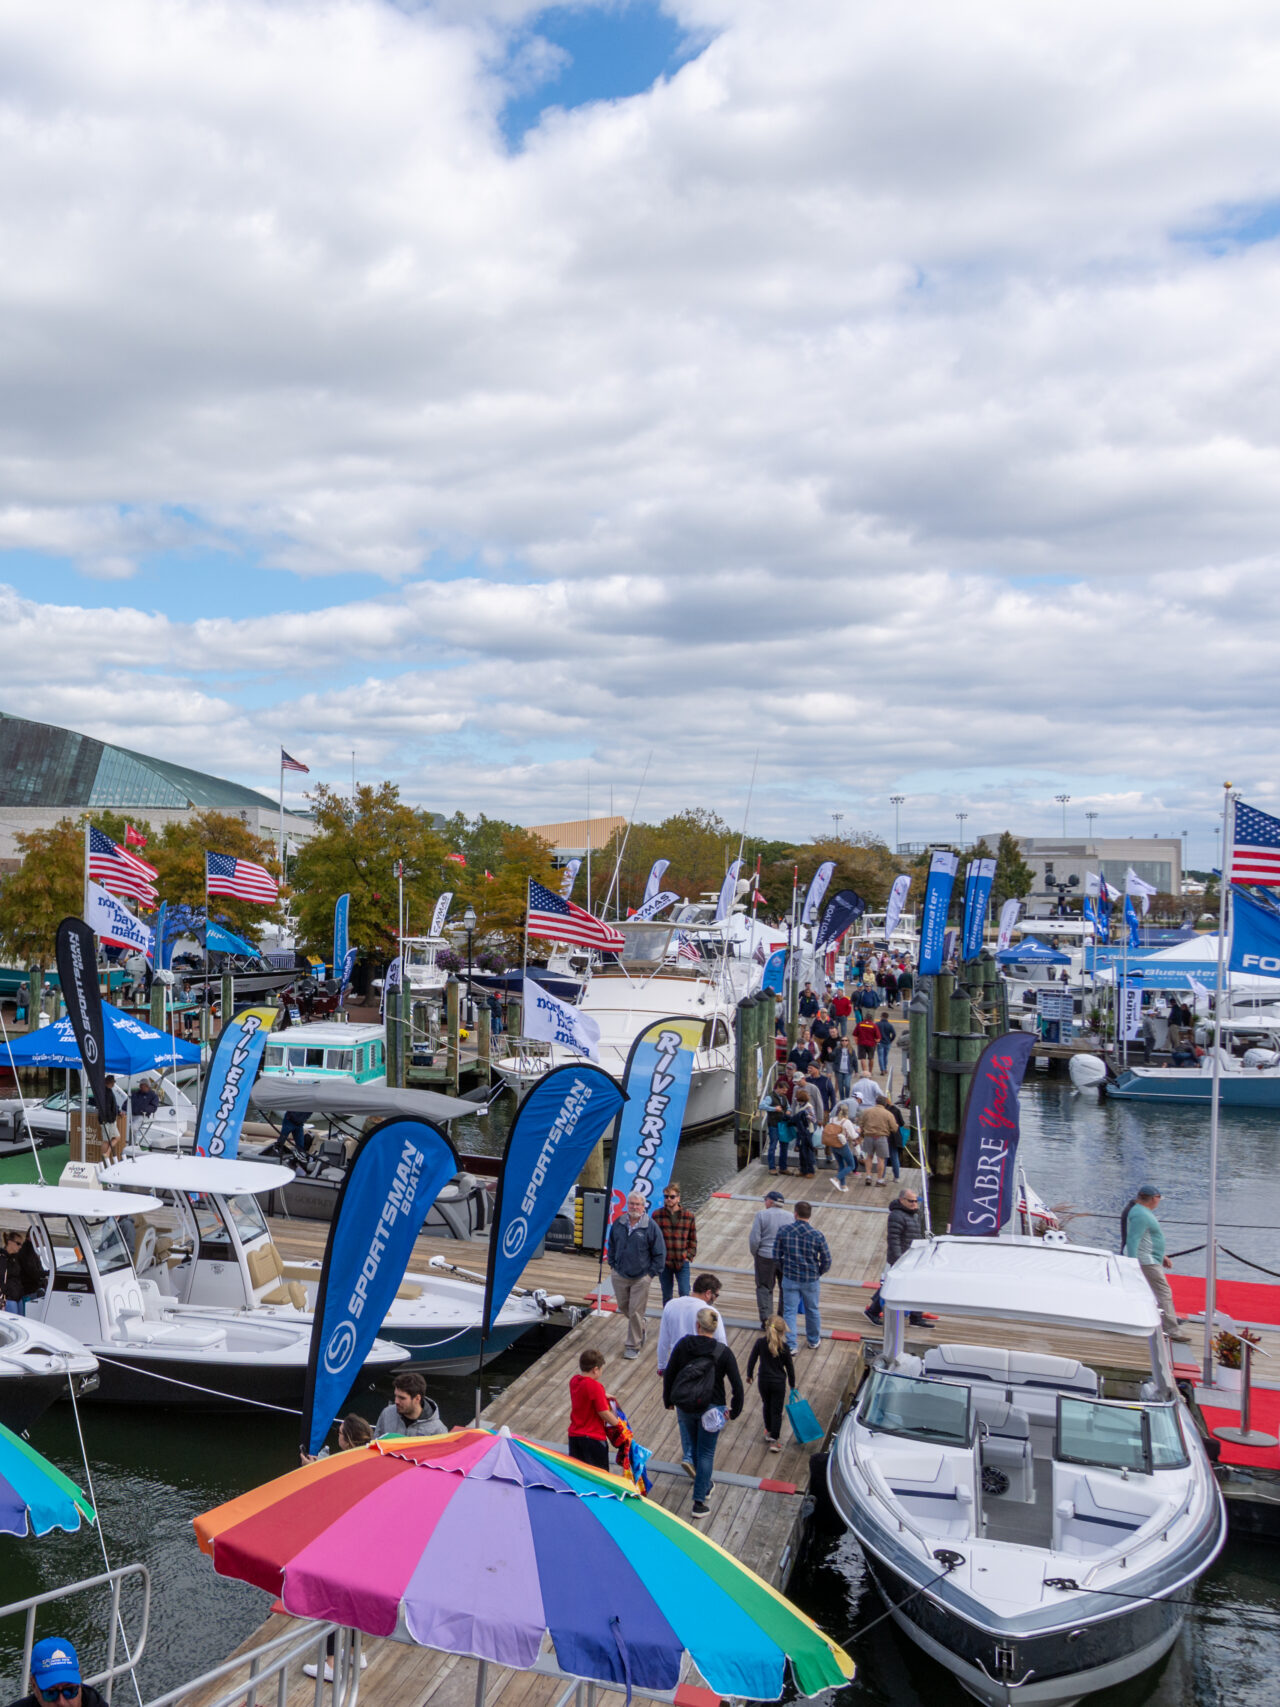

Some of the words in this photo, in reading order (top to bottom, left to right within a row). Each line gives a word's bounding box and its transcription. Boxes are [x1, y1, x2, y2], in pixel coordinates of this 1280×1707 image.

[111, 923, 148, 947] marin
[113, 911, 136, 931] bay
[433, 895, 448, 933] CAYMAS
[632, 893, 671, 922] AYMAS
[824, 904, 836, 922] BOAT
[924, 887, 938, 960] Bluewater
[969, 889, 985, 951] Bluewater
[68, 930, 91, 1032] SPORTSMAN
[74, 933, 84, 970] BOATS
[1145, 968, 1218, 978] Bluewater
[1125, 990, 1136, 1031] viking
[209, 1015, 261, 1156] RIVERSID
[565, 1087, 593, 1136] BOATS
[978, 1054, 1016, 1129] Yachts
[522, 1077, 585, 1216] SPORTSMAN
[632, 1030, 682, 1209] RIVERSID
[399, 1150, 424, 1217] BOATS
[967, 1137, 1009, 1228] SABRE
[347, 1139, 420, 1319] SPORTSMAN
